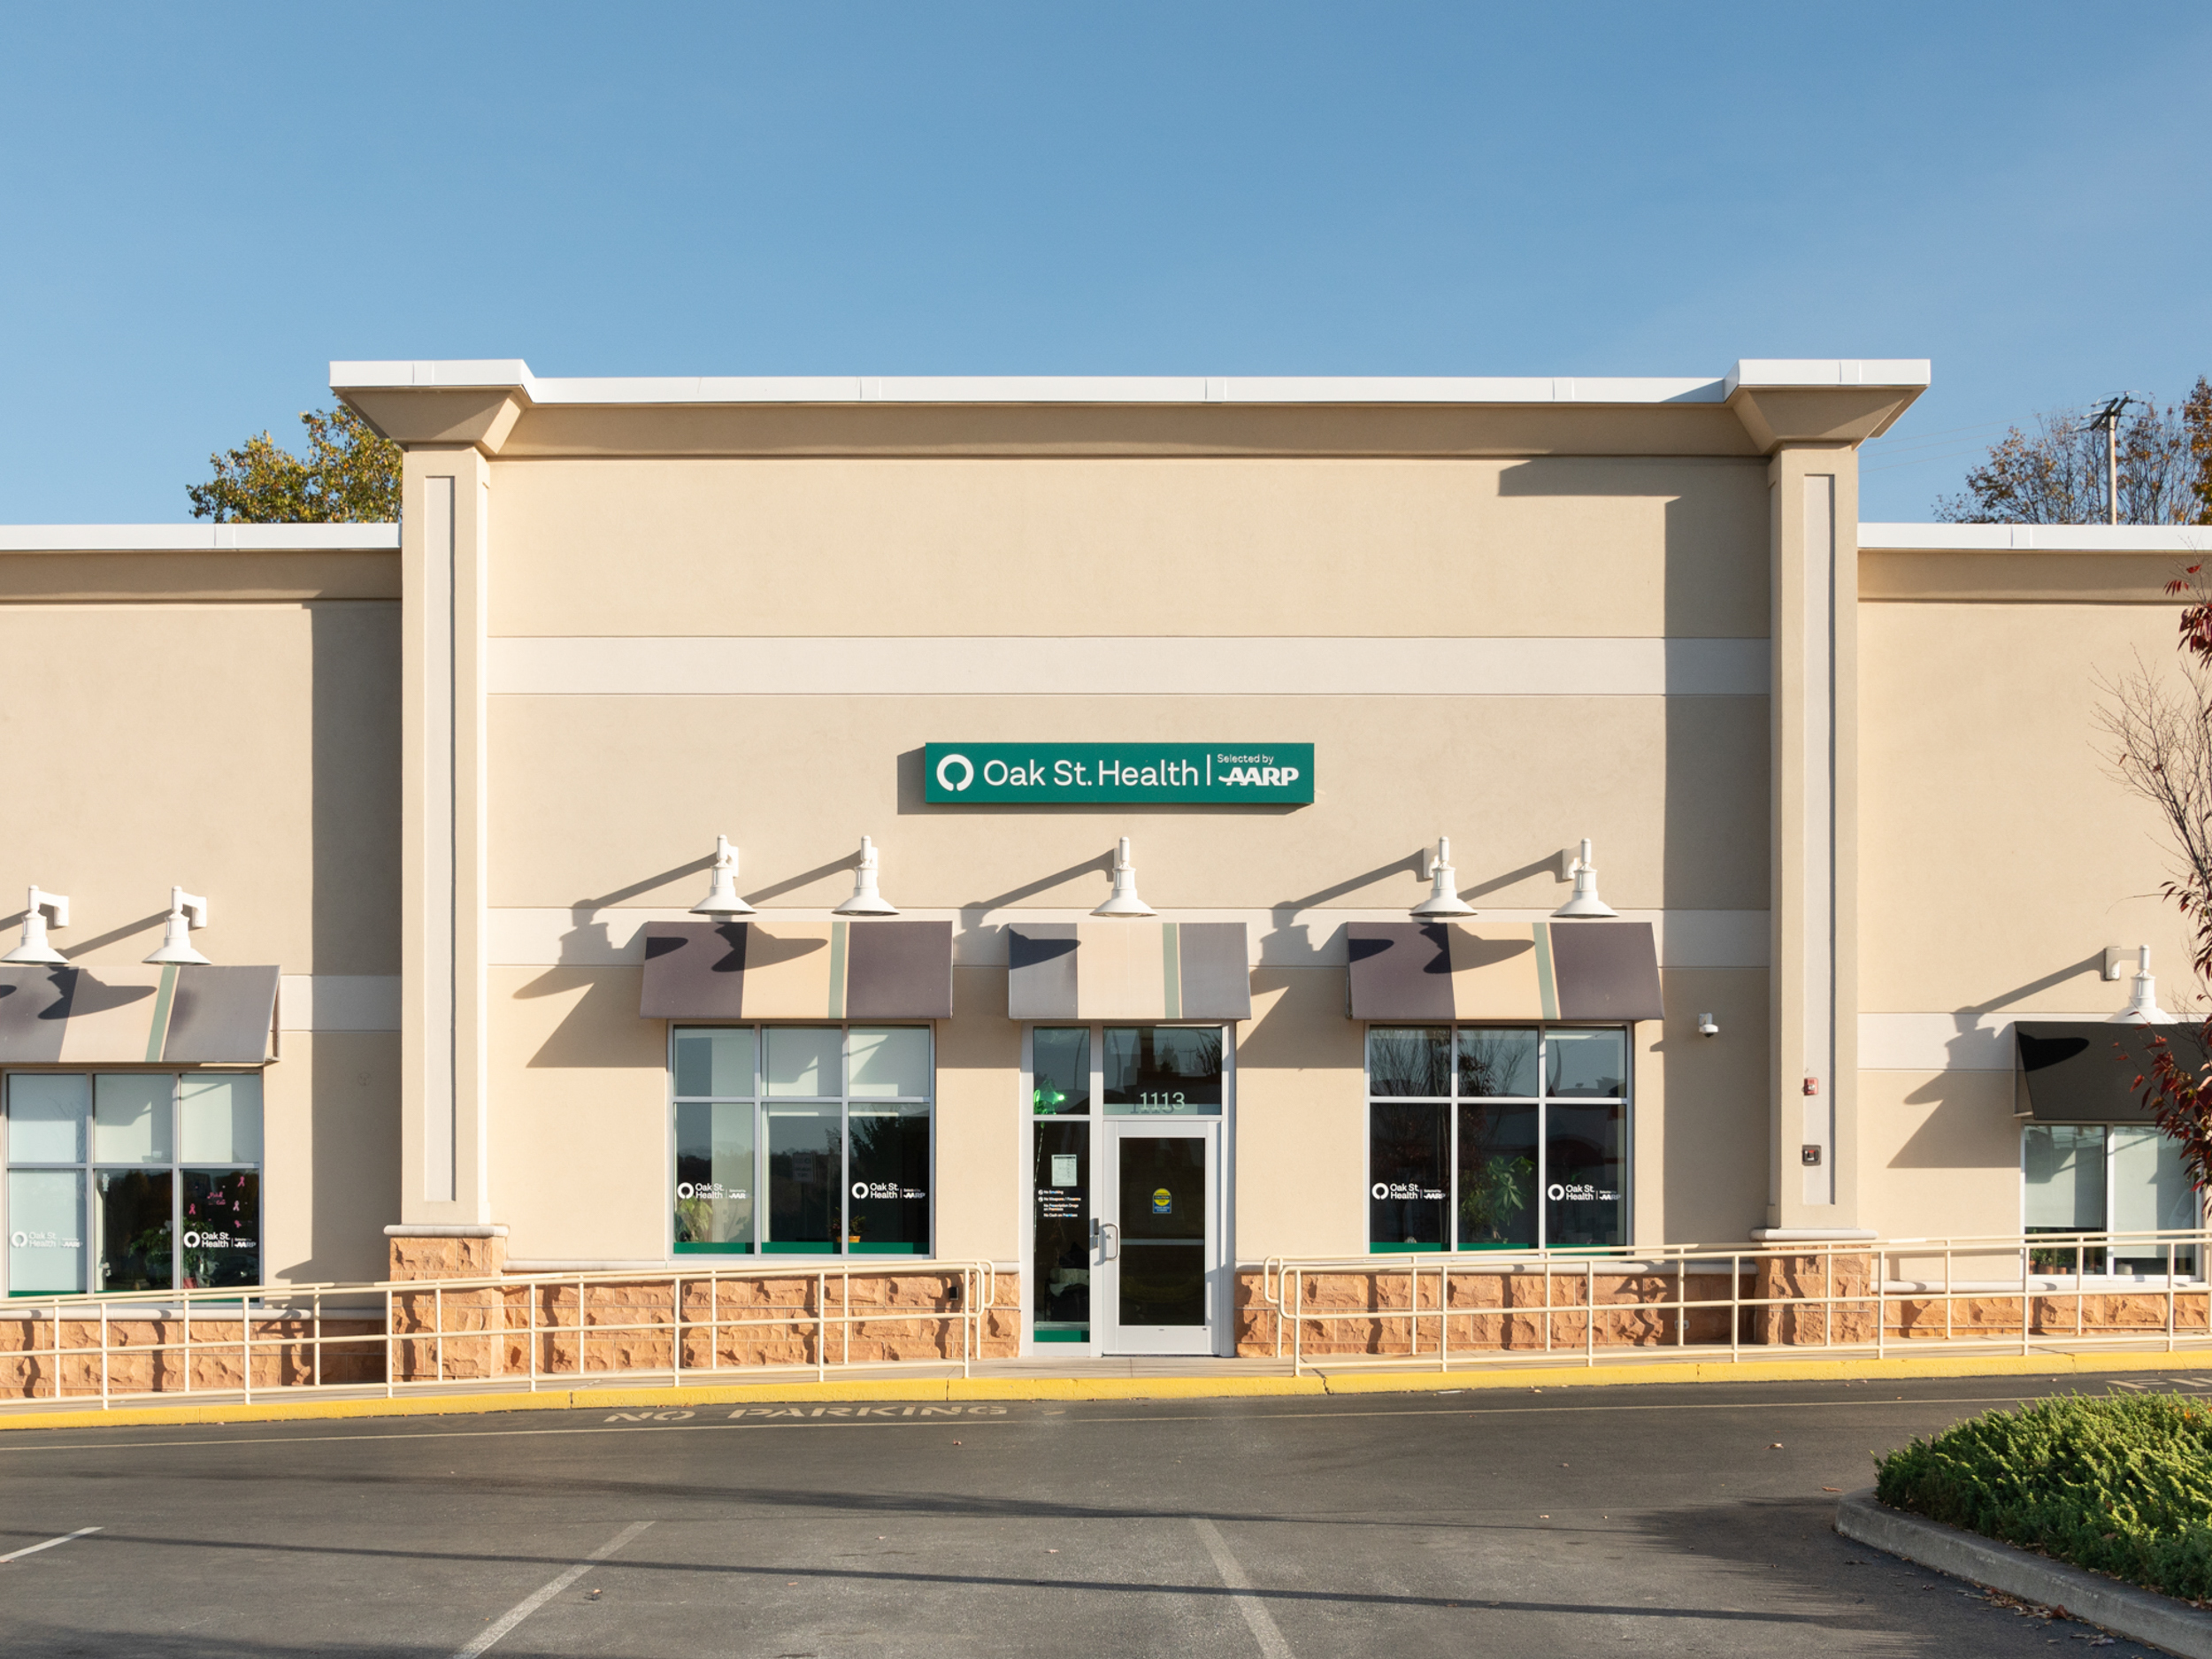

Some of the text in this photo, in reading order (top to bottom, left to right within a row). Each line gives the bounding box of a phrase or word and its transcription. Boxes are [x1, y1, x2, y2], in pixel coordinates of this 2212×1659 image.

[1217, 754, 1274, 765] Selected by
[983, 758, 1199, 787] Oak St. Health
[1217, 766, 1300, 787] AARP
[1140, 1091, 1186, 1110] 1113
[695, 1182, 712, 1191] Oak
[870, 1182, 887, 1191] Oak
[1389, 1182, 1407, 1192] Oak
[1565, 1184, 1583, 1193] Oak
[1390, 1191, 1418, 1200] Health
[1565, 1192, 1594, 1201] Health
[201, 1231, 219, 1240] Oak
[603, 1406, 1008, 1423] NO PARKING
